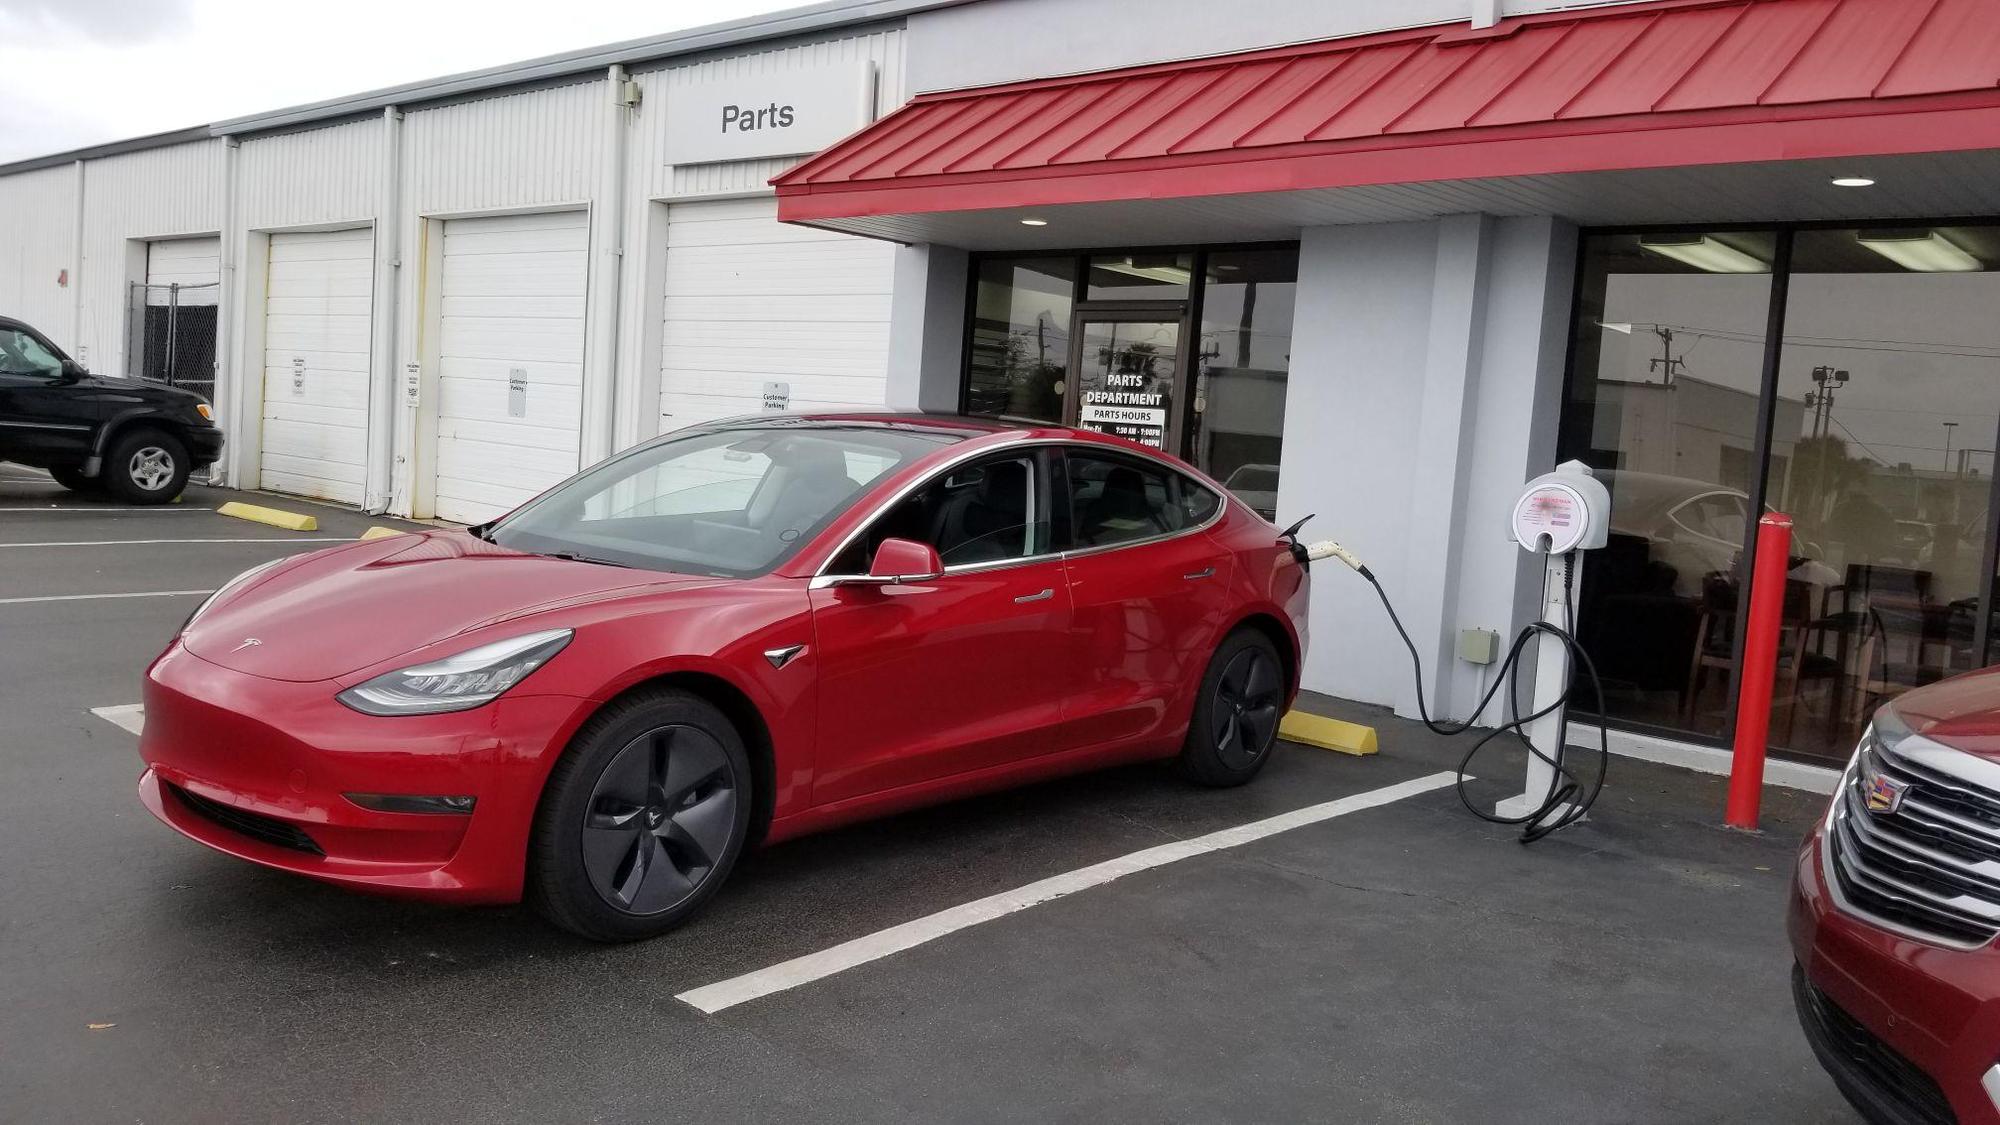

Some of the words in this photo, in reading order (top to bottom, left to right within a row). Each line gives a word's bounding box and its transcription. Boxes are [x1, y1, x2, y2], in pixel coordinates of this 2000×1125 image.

[722, 103, 794, 133] Parts
[1107, 375, 1143, 387] PARTS
[763, 393, 788, 401] Customer
[1086, 391, 1162, 406] DEPARTMENT
[764, 401, 785, 411] Parking
[1094, 409, 1120, 420] PARTS
[1121, 411, 1151, 421] HOURS
[1116, 426, 1128, 435] 7:30
[1128, 427, 1137, 435] AM
